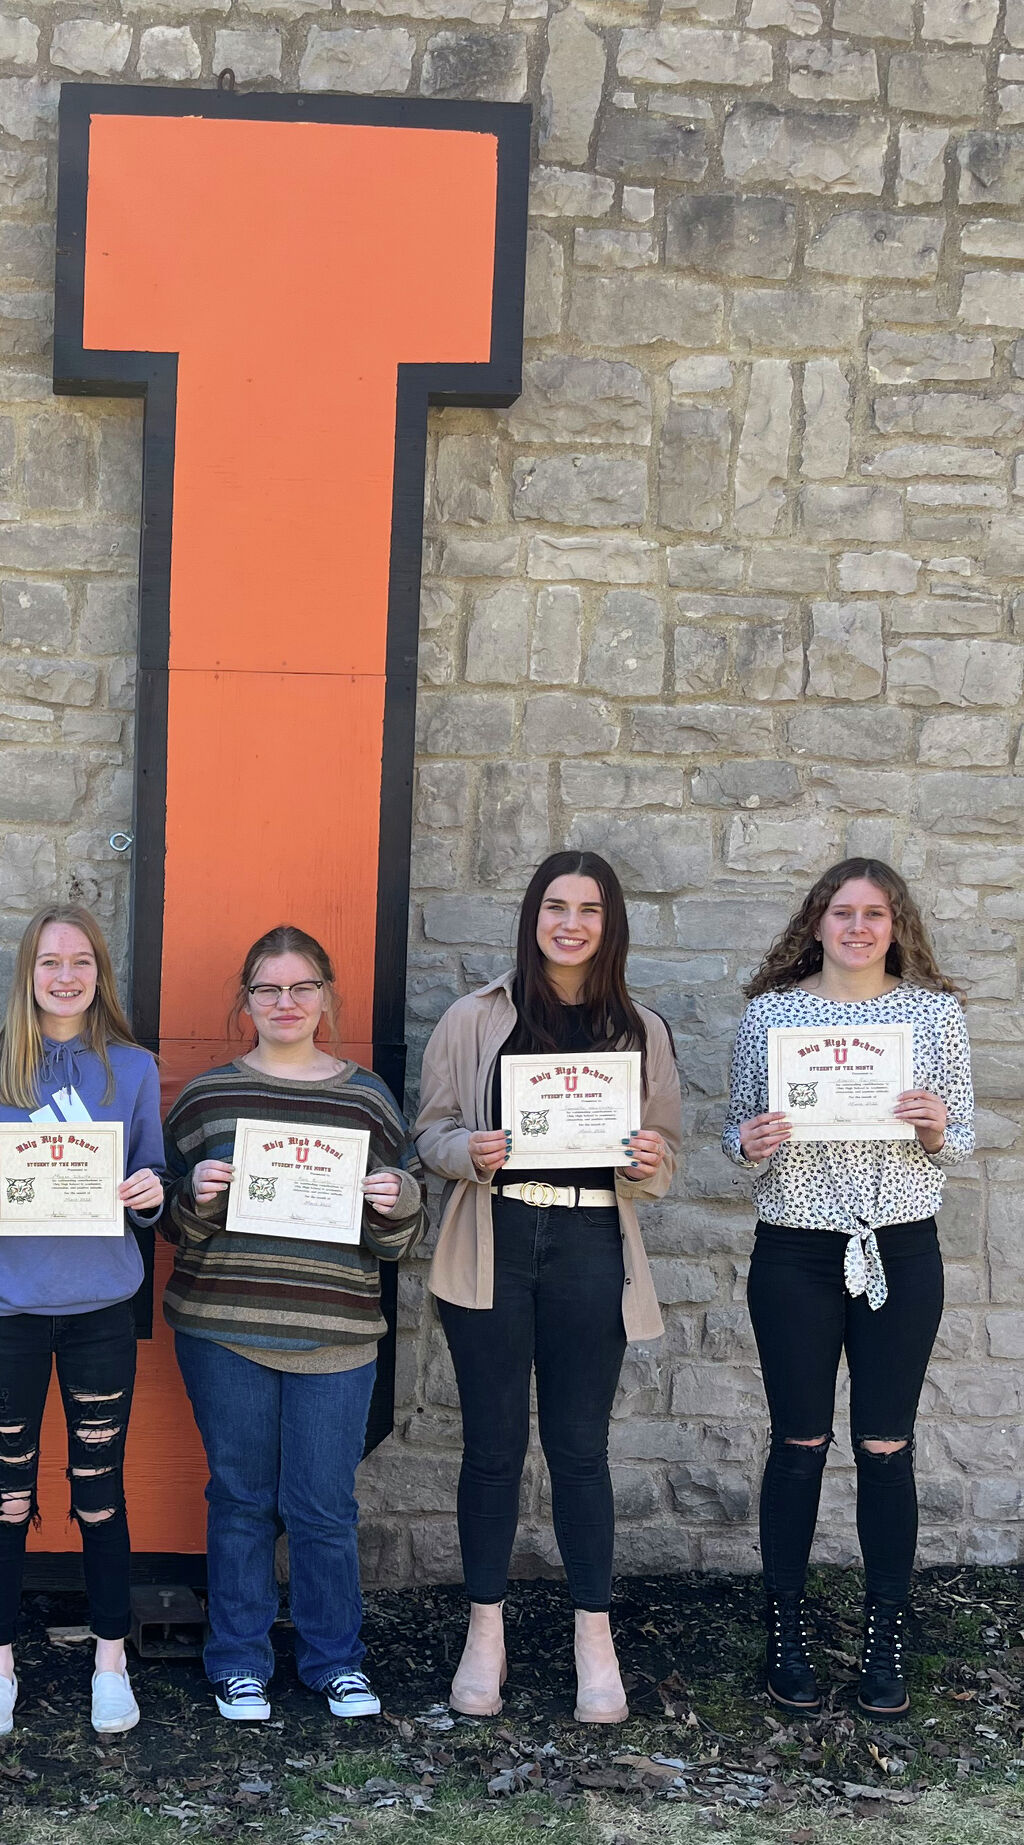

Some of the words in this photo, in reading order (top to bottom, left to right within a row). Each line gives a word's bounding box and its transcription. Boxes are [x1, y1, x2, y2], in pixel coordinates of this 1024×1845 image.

[823, 1038, 846, 1047] High
[852, 1038, 885, 1056] School
[834, 1048, 848, 1064] U
[554, 1066, 577, 1076] High
[582, 1066, 613, 1084] School
[564, 1076, 578, 1092] U
[40, 1135, 62, 1144] High
[68, 1136, 100, 1154] School
[50, 1144, 64, 1160] U
[288, 1137, 309, 1146] High
[314, 1140, 344, 1160] School
[296, 1147, 309, 1162] U
